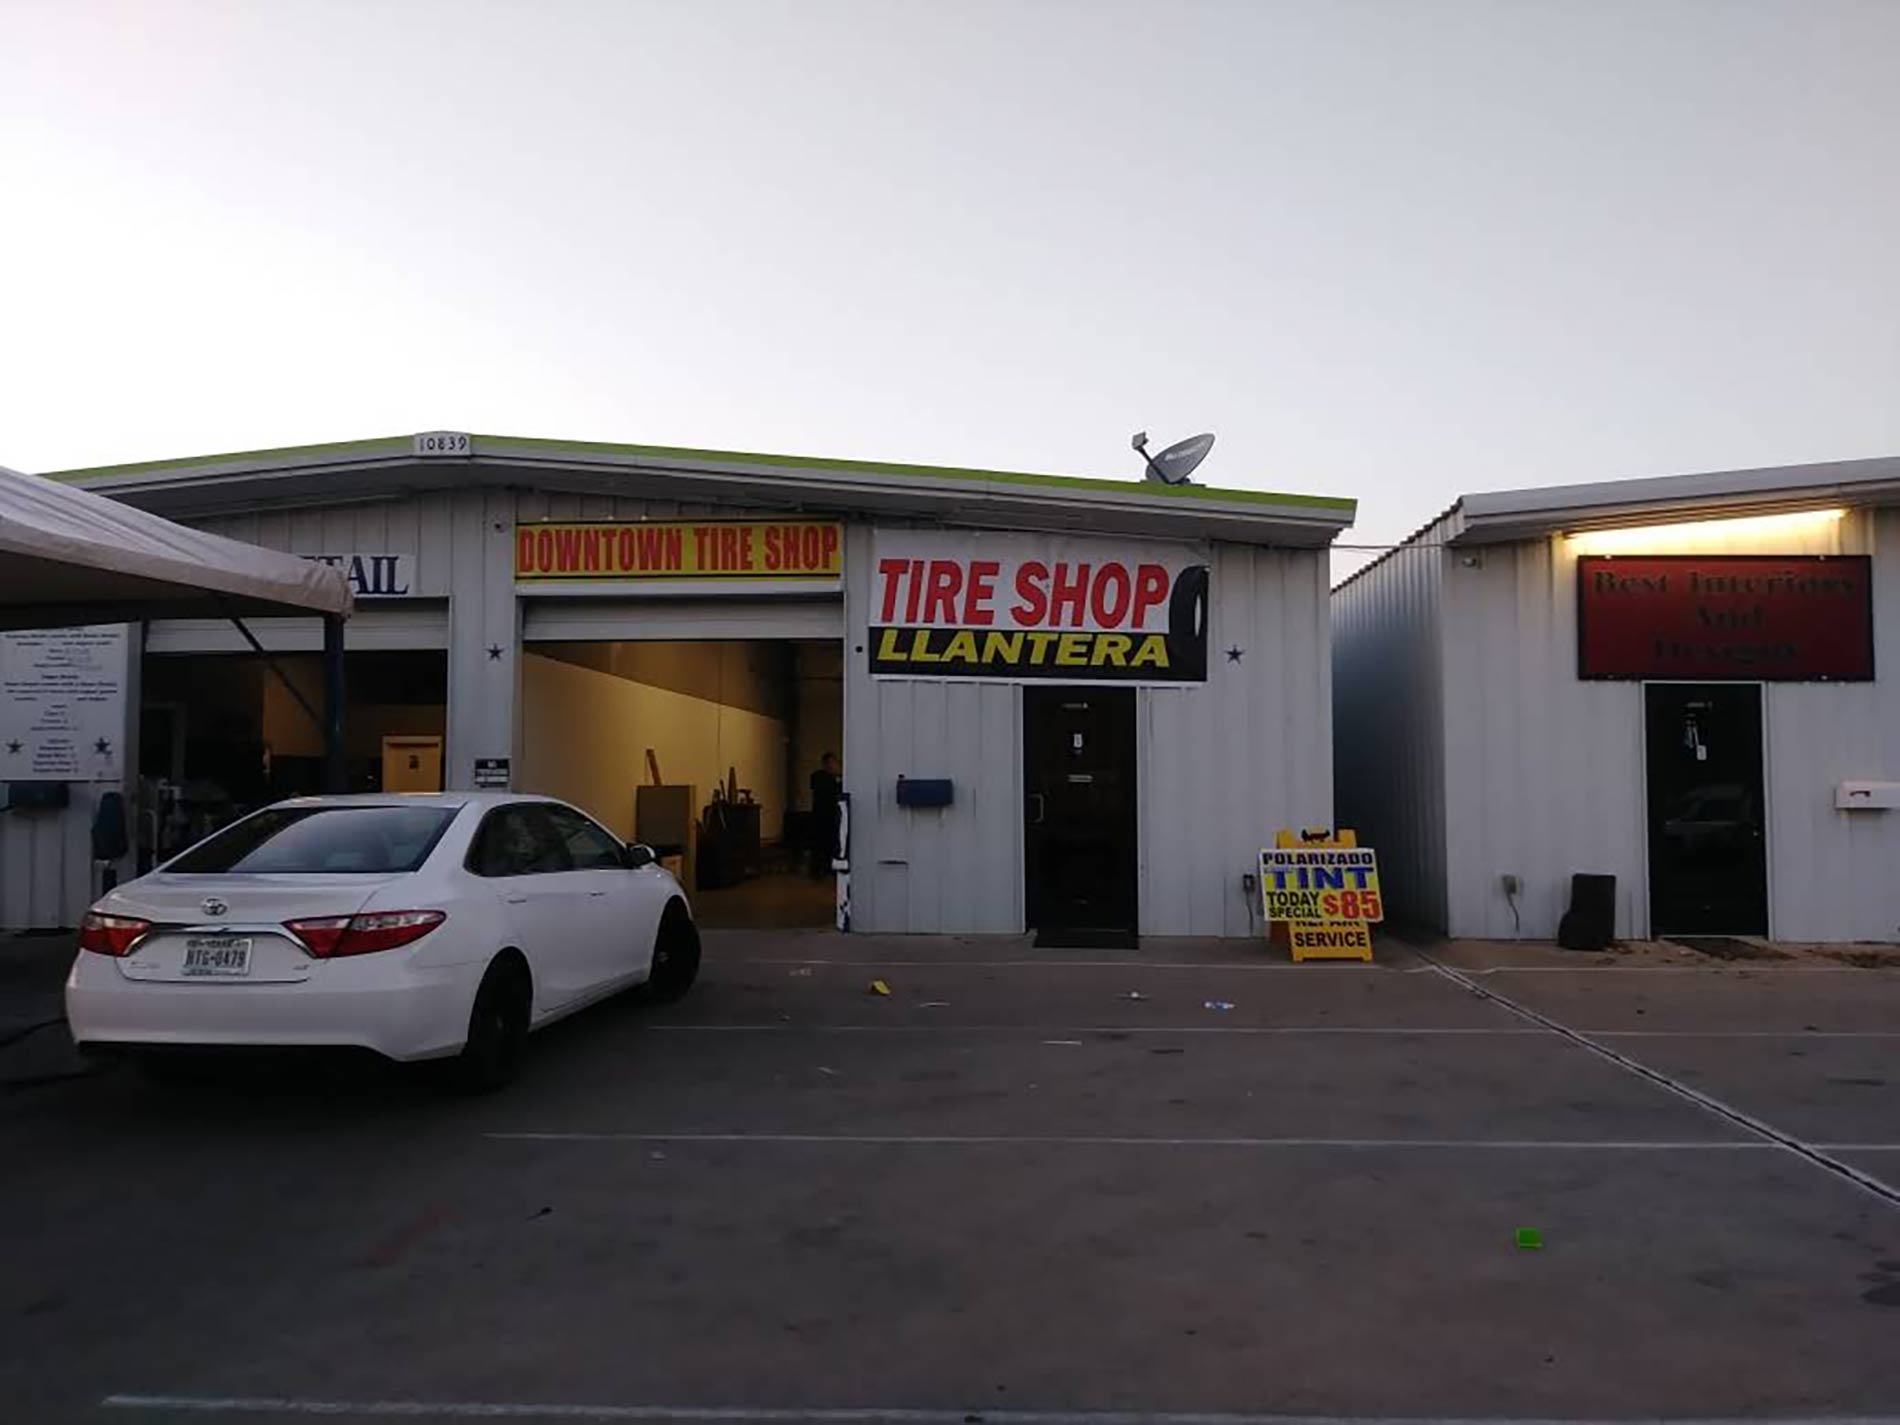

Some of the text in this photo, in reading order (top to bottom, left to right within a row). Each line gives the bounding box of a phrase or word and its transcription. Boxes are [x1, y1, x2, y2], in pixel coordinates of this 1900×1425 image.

[420, 436, 467, 452] 10839
[519, 525, 838, 573] DOWNTOWN TIRE SHOP
[299, 555, 409, 595] AIL
[879, 558, 1170, 630] TIRE SHOP
[877, 629, 1170, 668] LLANTERA
[1263, 852, 1373, 866] POLARIZADO
[1264, 866, 1374, 889] TINT
[1266, 891, 1320, 906] TODAY
[1323, 891, 1381, 919] $85
[1269, 907, 1322, 918] SPECIAL
[1295, 932, 1367, 947] SERVICE
